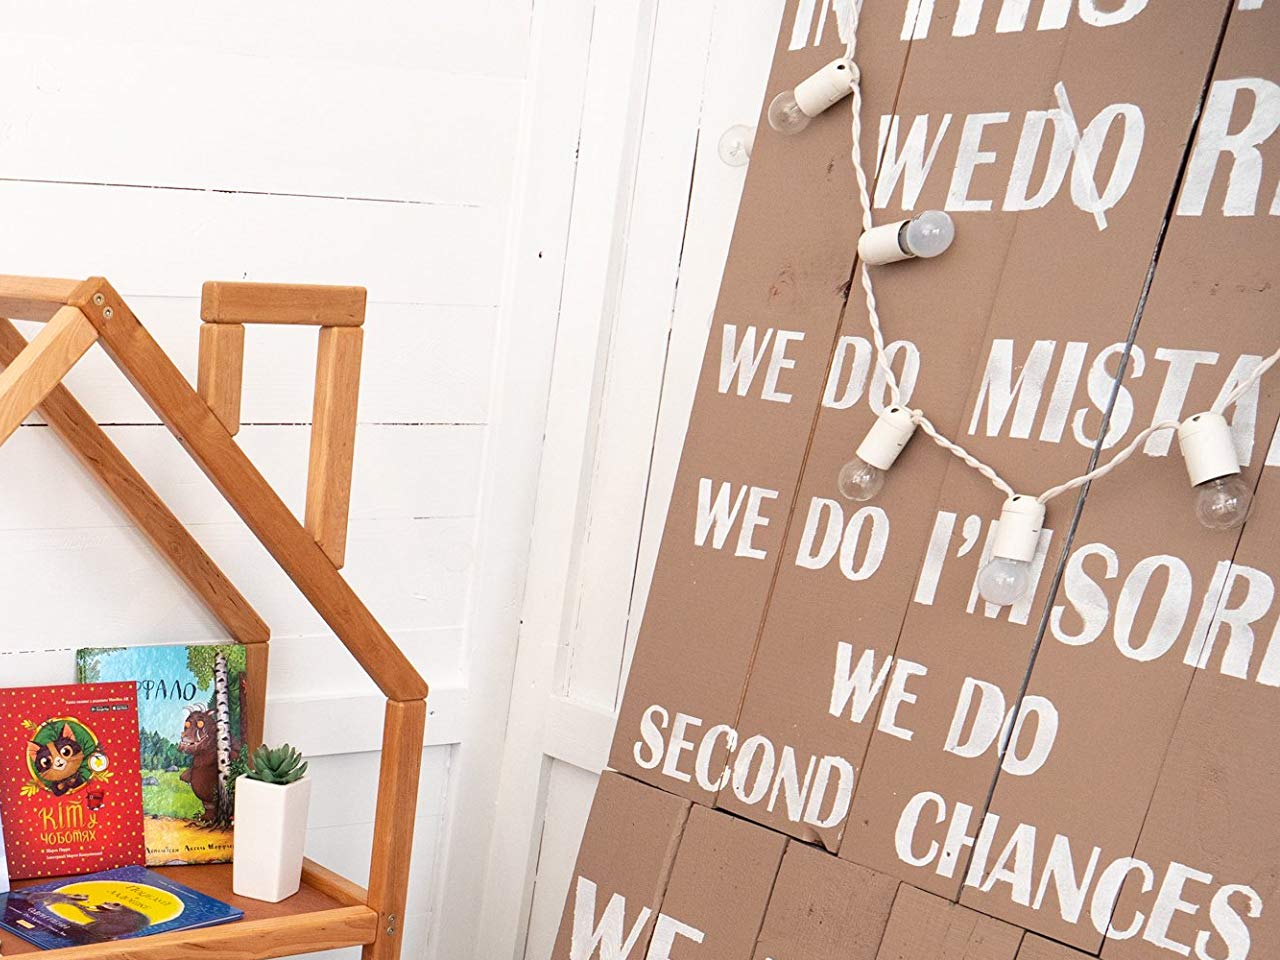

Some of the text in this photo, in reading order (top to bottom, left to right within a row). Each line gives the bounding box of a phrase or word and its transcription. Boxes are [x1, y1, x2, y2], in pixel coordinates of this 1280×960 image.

[1176, 77, 1280, 217] R
[718, 324, 1280, 467] WE DO MISTA
[693, 477, 779, 559] WE
[795, 496, 890, 581] DO
[1050, 542, 1280, 688] SOR
[633, 704, 854, 829] SECOND
[829, 641, 1059, 776] WE DO
